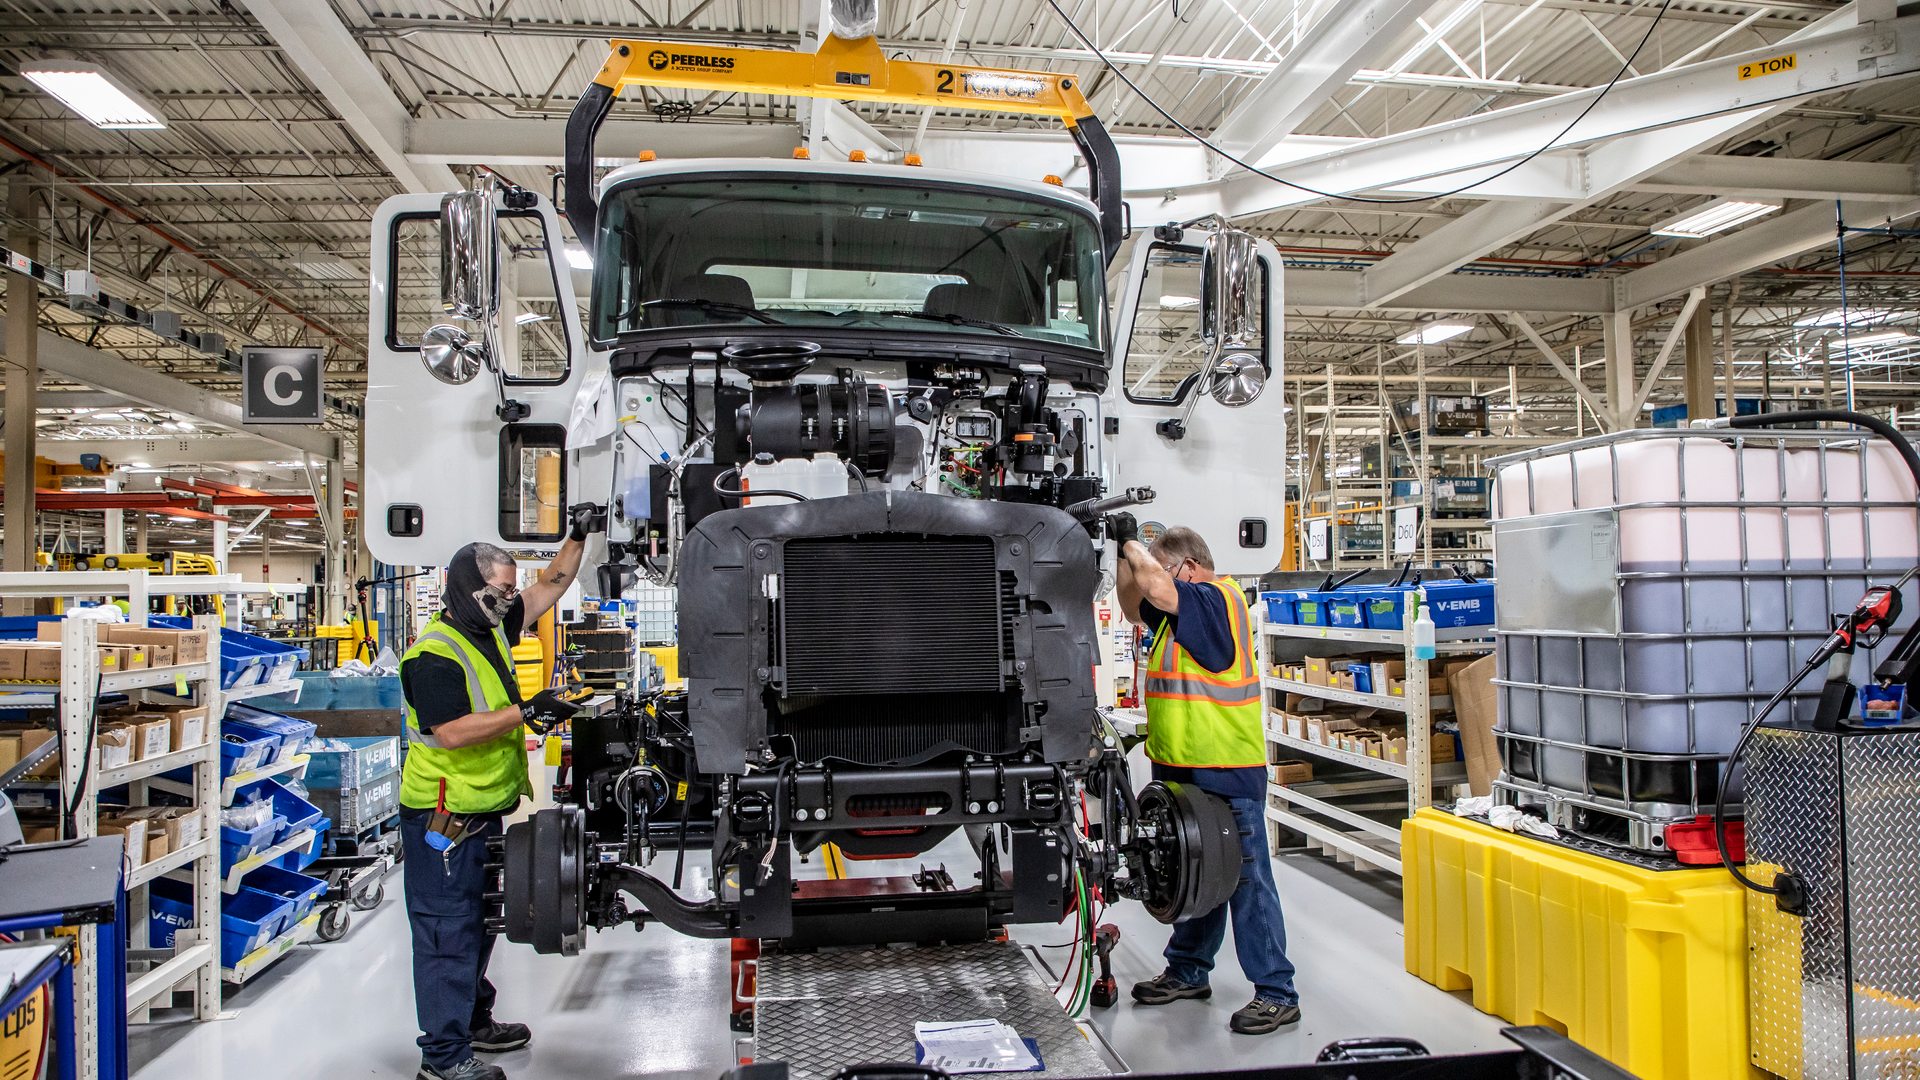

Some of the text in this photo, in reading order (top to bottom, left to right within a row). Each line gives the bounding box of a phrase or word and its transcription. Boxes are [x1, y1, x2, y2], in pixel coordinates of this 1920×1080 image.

[671, 54, 735, 68] PEERLESS
[1742, 56, 1793, 78] 2 TON
[936, 69, 954, 94] 2
[263, 364, 303, 407] C
[1312, 533, 1325, 548] D50
[1398, 523, 1414, 540] D60
[1437, 599, 1481, 611] V-EMB
[365, 744, 391, 766] V-EMB
[364, 780, 392, 805] V-EMB
